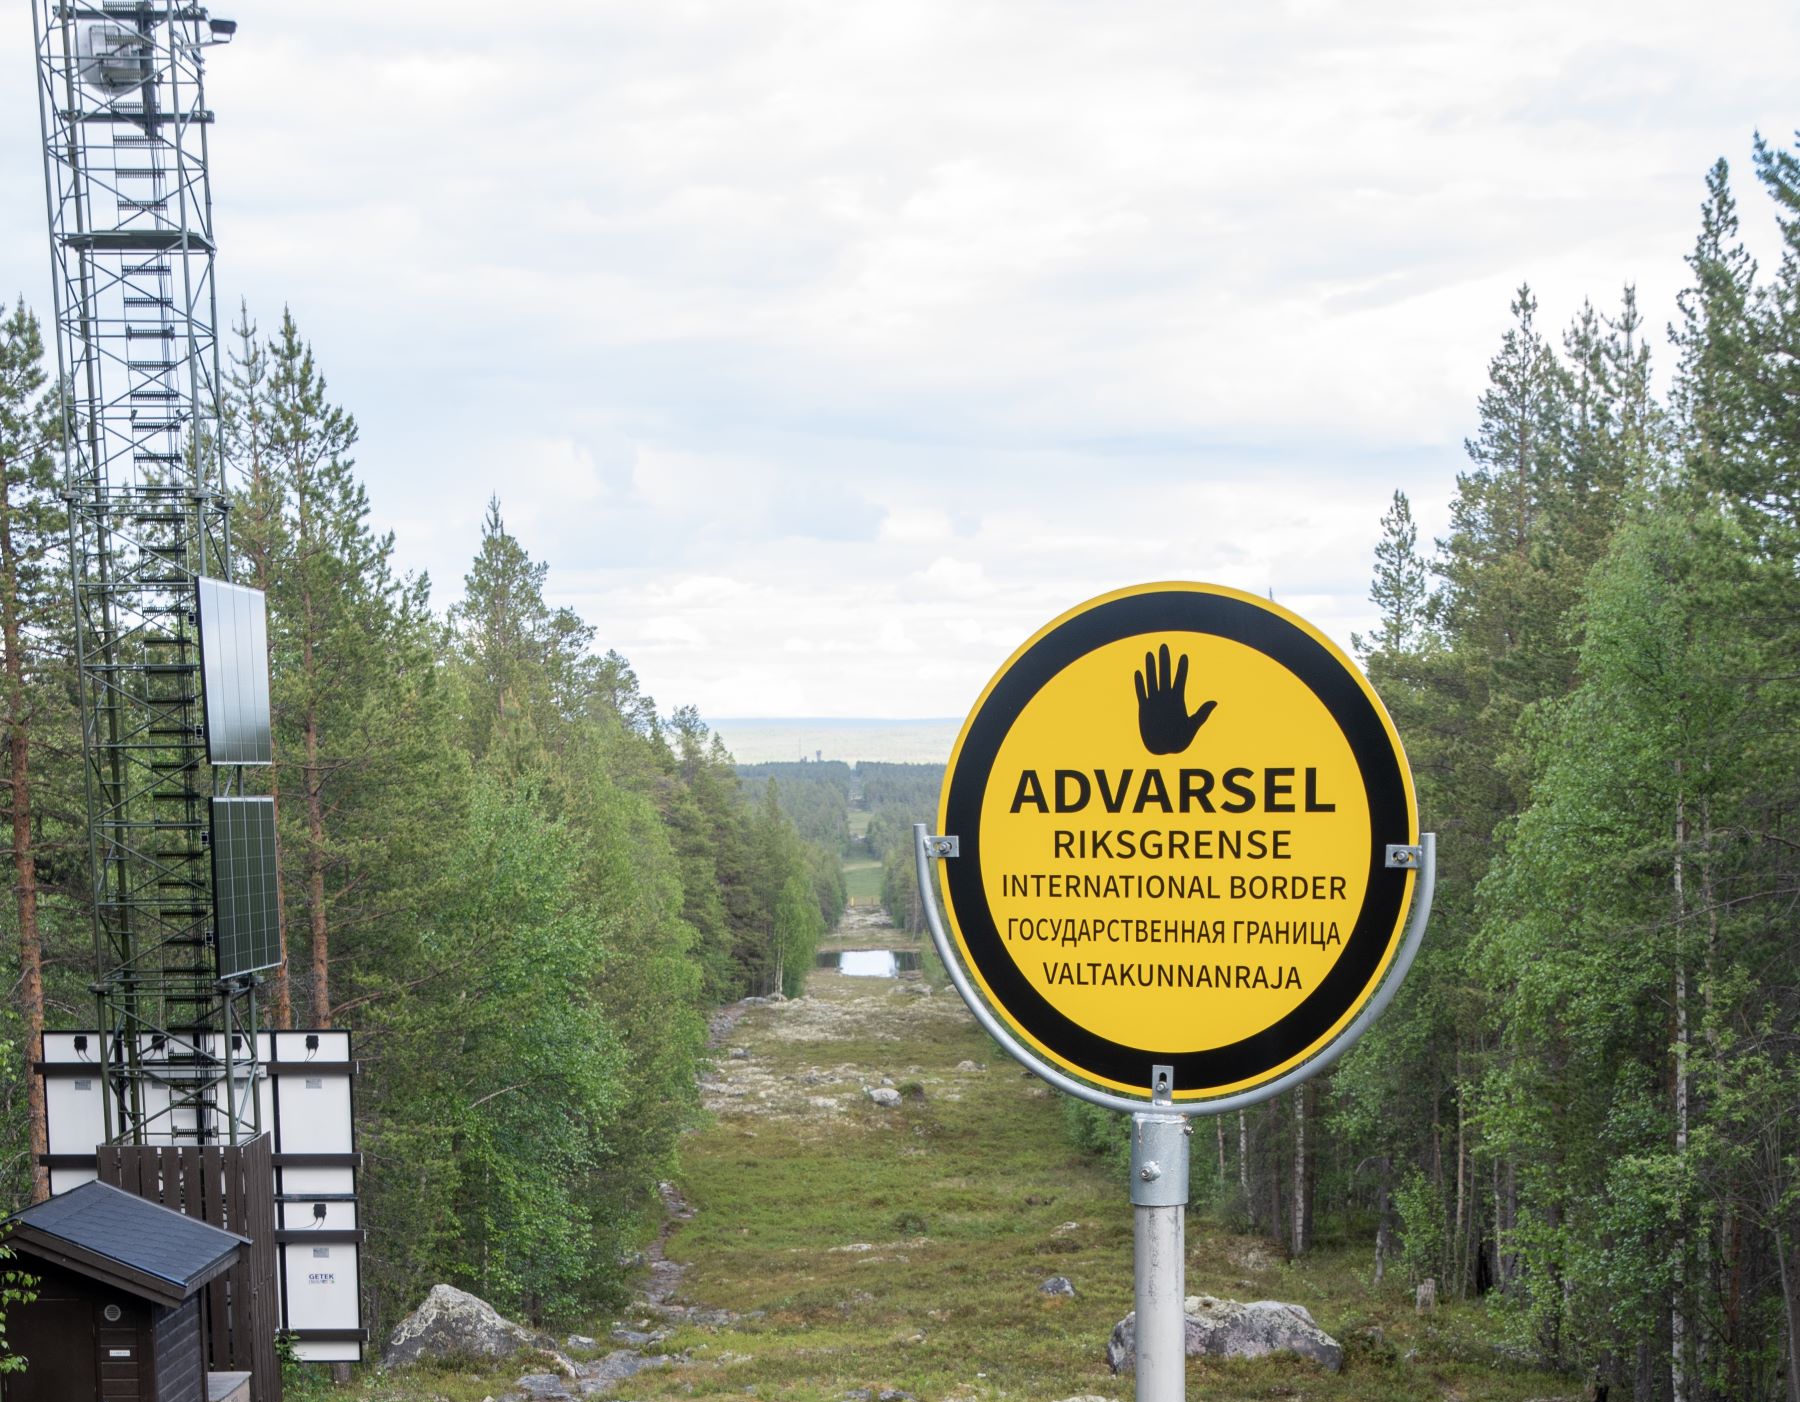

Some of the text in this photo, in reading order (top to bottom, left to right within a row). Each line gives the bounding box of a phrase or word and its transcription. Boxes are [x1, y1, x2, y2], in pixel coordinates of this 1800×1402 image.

[1009, 767, 1336, 814] ADVARSEL
[1053, 829, 1292, 860] RIKSGRENSE
[1002, 874, 1346, 900] INTERNATIONAL BORDER
[1007, 917, 1341, 951] ГОСУДАРСТВЕННАЯ ГРАНИЦА
[1042, 962, 1302, 990] VALTAKUNNANRAJA
